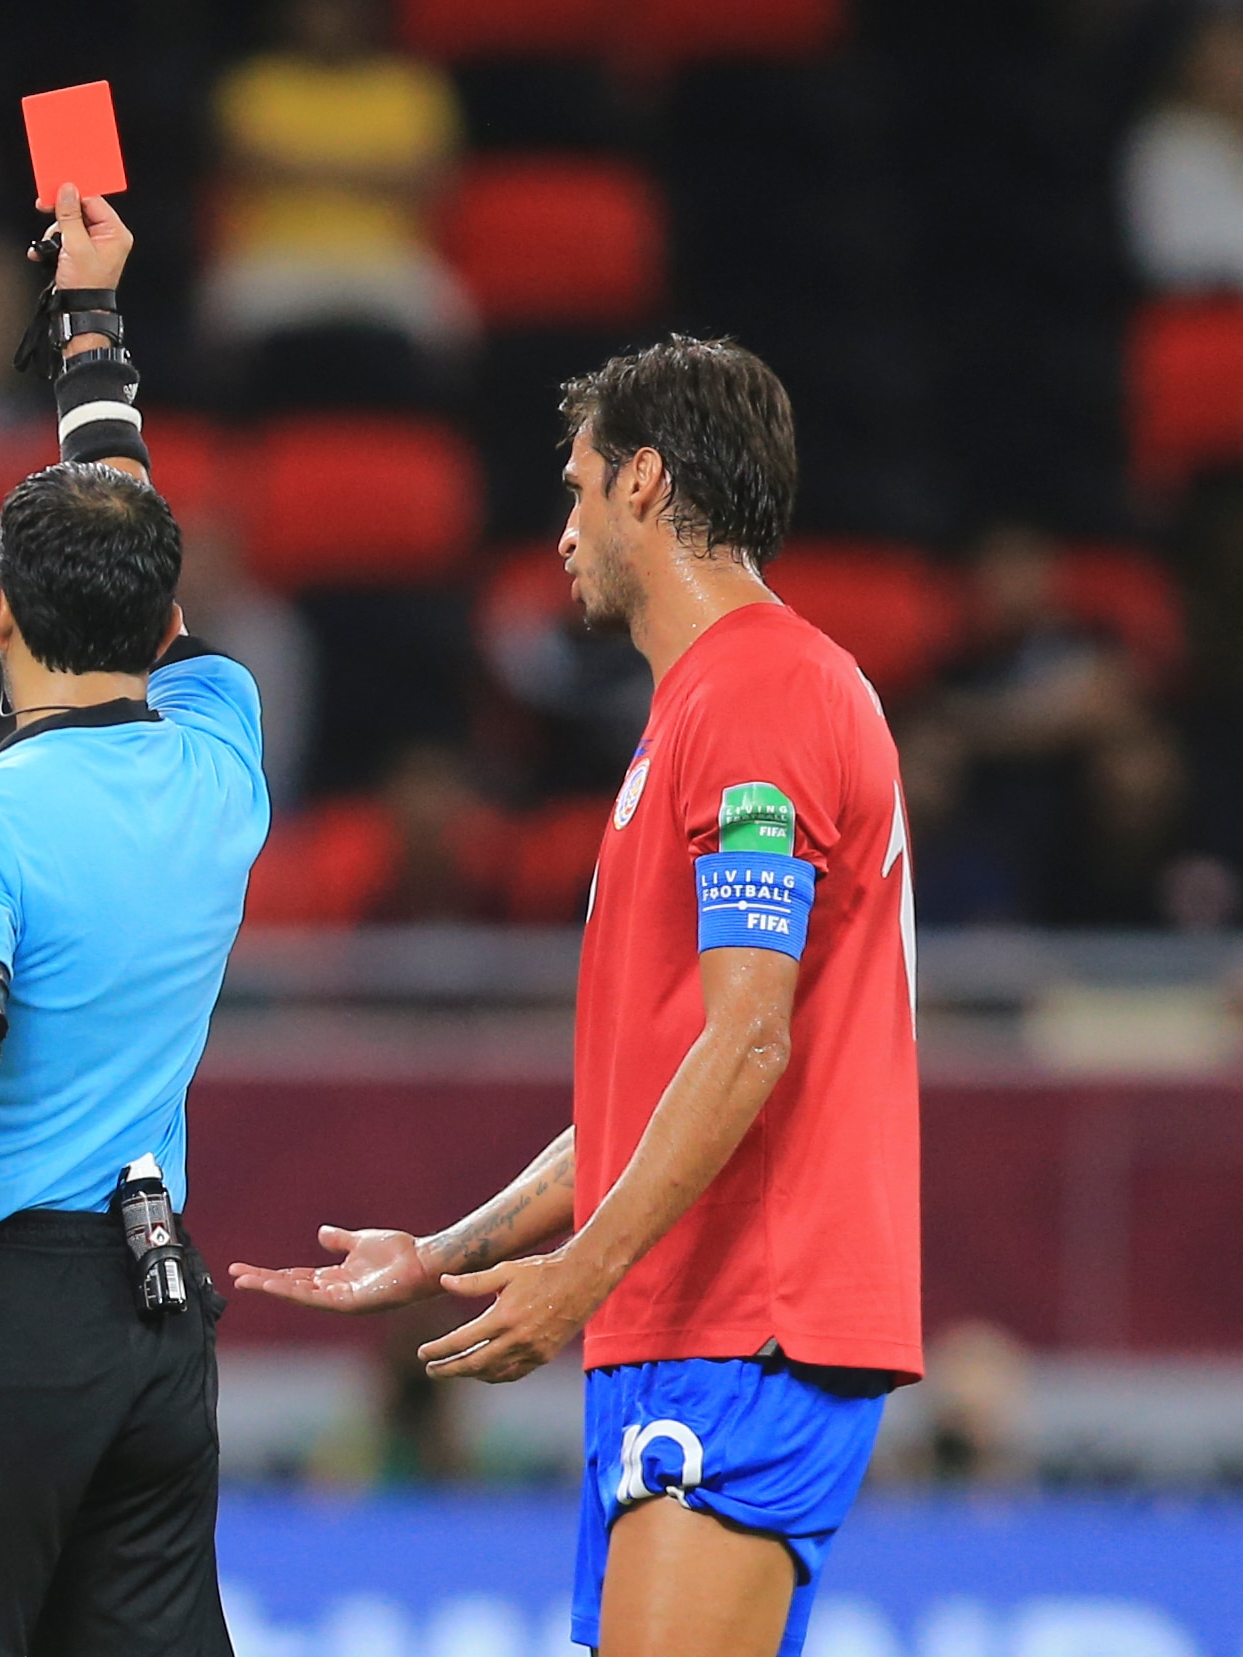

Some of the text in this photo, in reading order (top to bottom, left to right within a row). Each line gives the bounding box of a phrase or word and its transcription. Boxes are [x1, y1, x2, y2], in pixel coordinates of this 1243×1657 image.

[759, 826, 787, 837] FIFA
[702, 870, 795, 888] LIVING
[702, 884, 792, 903] FOOTBALL
[747, 913, 791, 934] FIFA
[617, 1419, 704, 1508] 10
